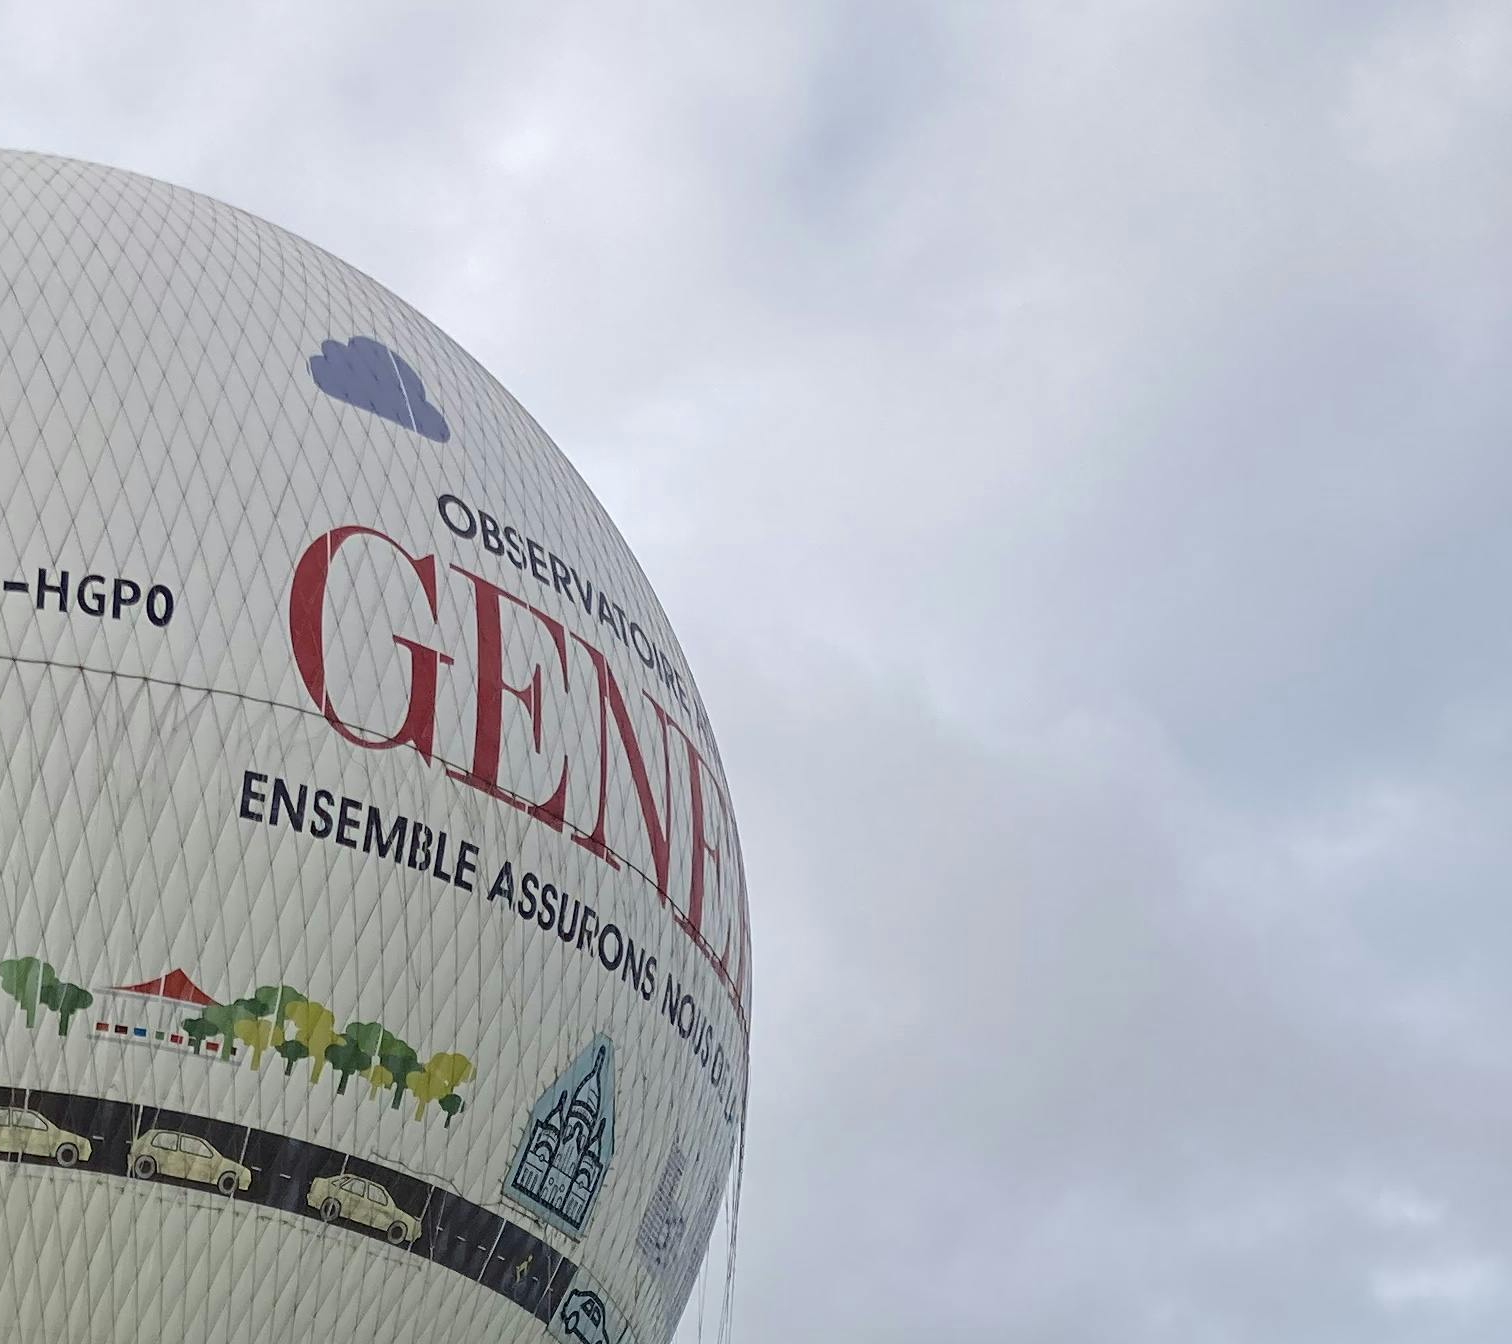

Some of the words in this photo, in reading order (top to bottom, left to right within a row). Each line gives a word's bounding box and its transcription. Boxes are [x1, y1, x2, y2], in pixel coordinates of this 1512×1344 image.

[437, 494, 691, 717] OBSERVATOIRE
[239, 770, 480, 892] ENSEMBLE
[488, 861, 657, 1001] ASSURONS
[661, 973, 713, 1068] NOUS
